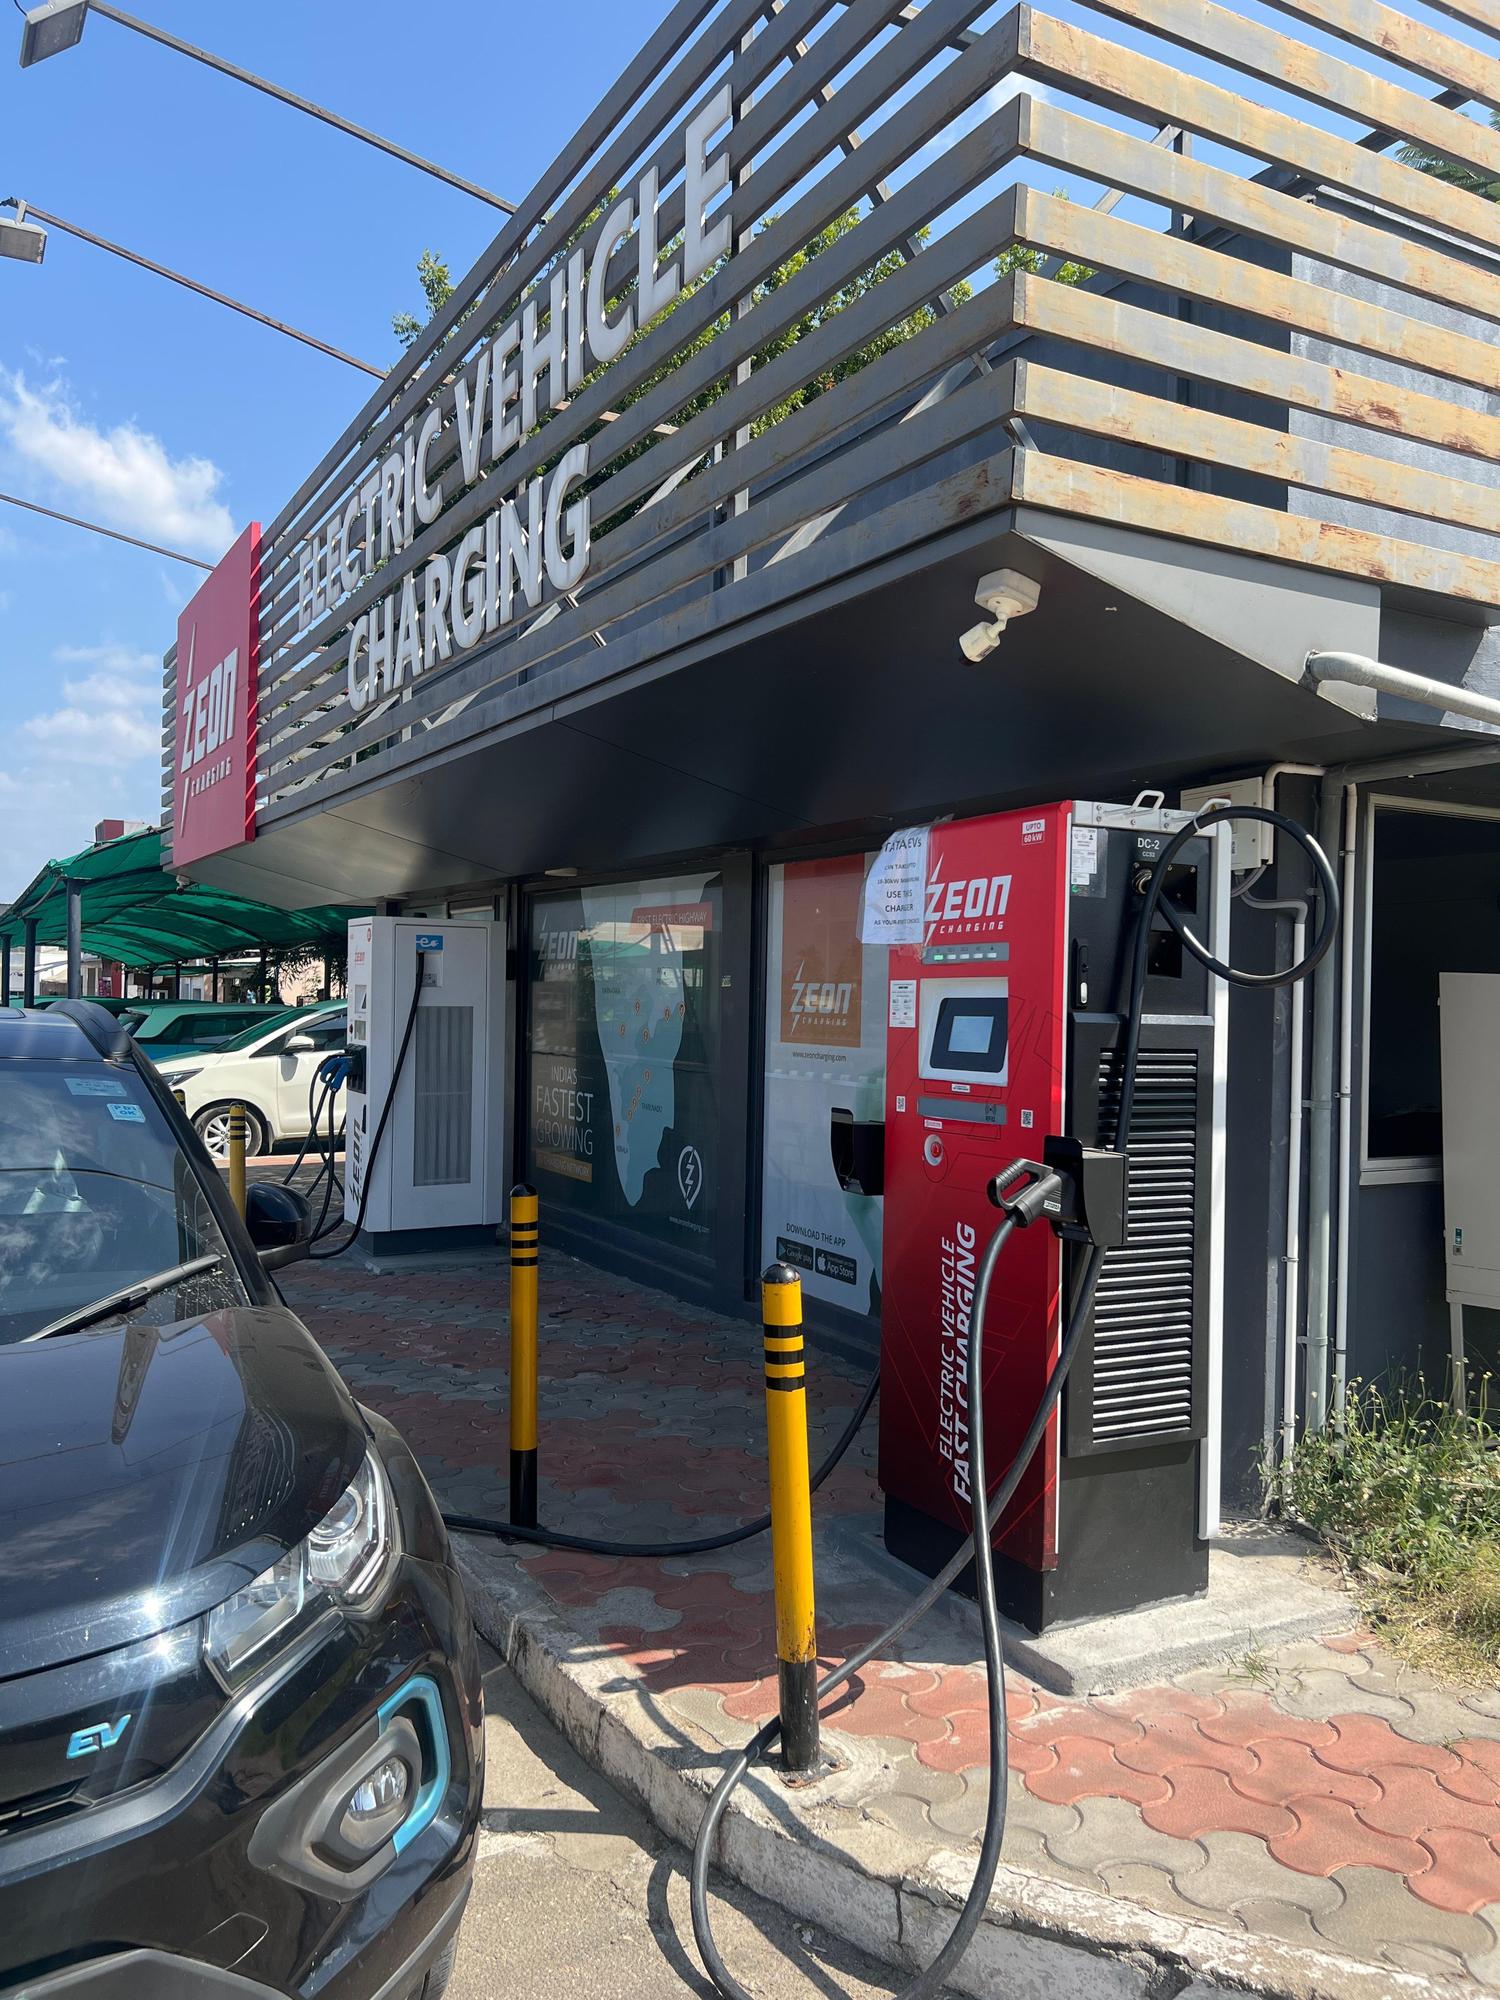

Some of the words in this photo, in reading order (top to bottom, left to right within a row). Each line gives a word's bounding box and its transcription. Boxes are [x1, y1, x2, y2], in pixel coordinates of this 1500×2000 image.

[298, 407, 443, 634] ELECTRIC
[454, 83, 733, 485] VEHICLE
[347, 442, 591, 712] CHARGING
[180, 647, 239, 774] ZEON
[191, 756, 233, 798] CHARGING
[1025, 821, 1042, 831] UPTO
[1137, 837, 1160, 850] DC-2
[886, 890, 902, 899] USE
[924, 874, 1013, 922] ZEON
[678, 912, 707, 924] HIGHWAY
[940, 921, 1004, 934] CHARGING
[538, 930, 578, 961] ZEON
[790, 982, 852, 1015] ZEON
[802, 1016, 847, 1027] CHARGING
[551, 1065, 578, 1085] INDIA'S
[536, 1085, 594, 1123] FASTEST
[536, 1118, 593, 1156] GROWING
[786, 1222, 820, 1241] DOWNLOAD
[820, 1233, 833, 1245] THE
[833, 1236, 846, 1248] APP
[826, 1261, 839, 1278] App
[839, 1264, 855, 1279] Store
[941, 1236, 955, 1338] VEHICLE
[940, 1343, 955, 1461] ELECTRIC
[953, 1411, 972, 1505] FAST
[66, 1713, 132, 1760] EV
